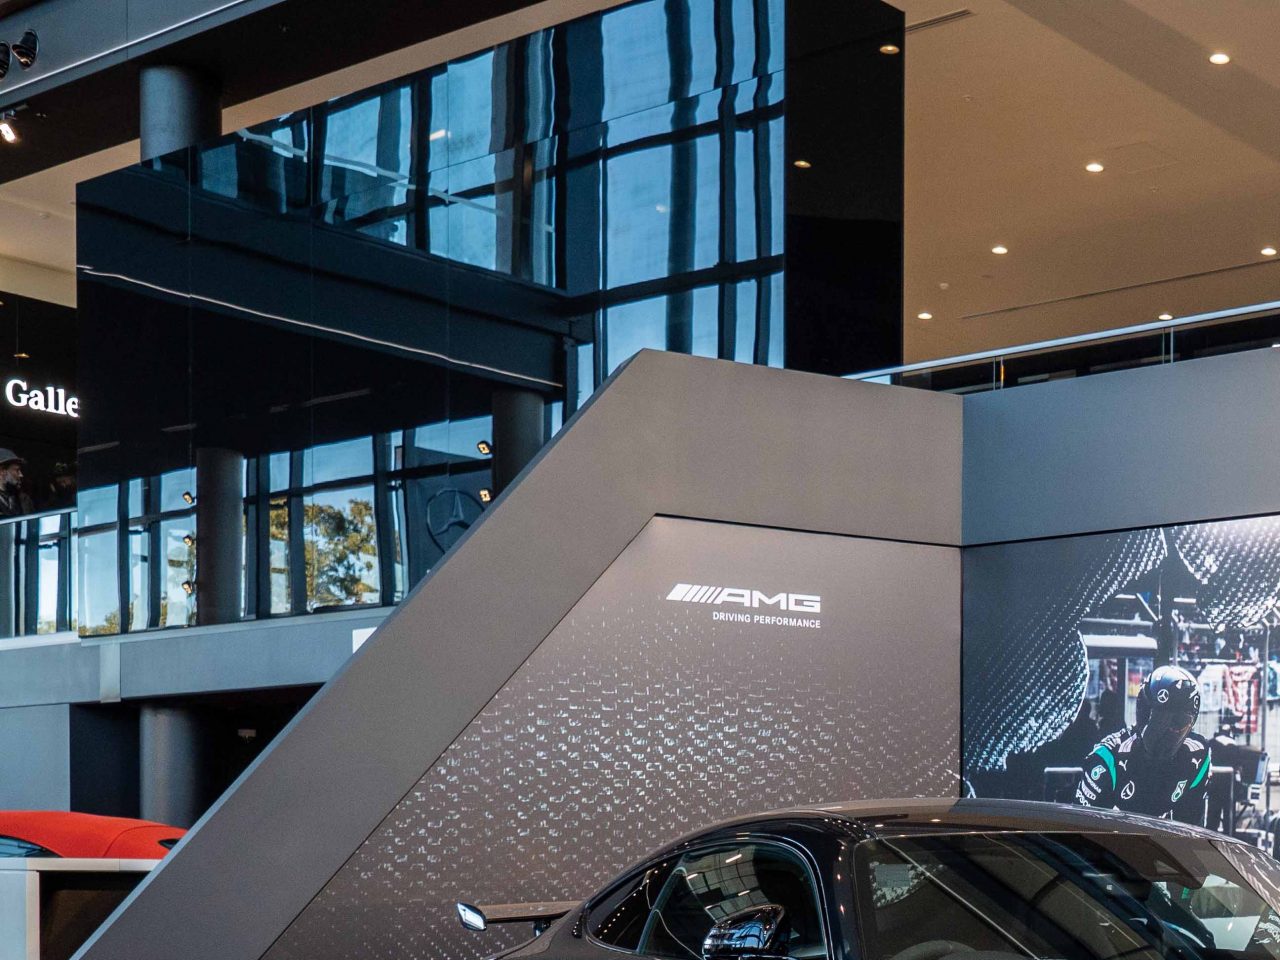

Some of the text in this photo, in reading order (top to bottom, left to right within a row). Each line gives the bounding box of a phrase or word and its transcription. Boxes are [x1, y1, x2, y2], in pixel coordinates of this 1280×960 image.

[713, 587, 821, 613] AMG
[712, 611, 821, 629] DRIVING PERFORMANCE
